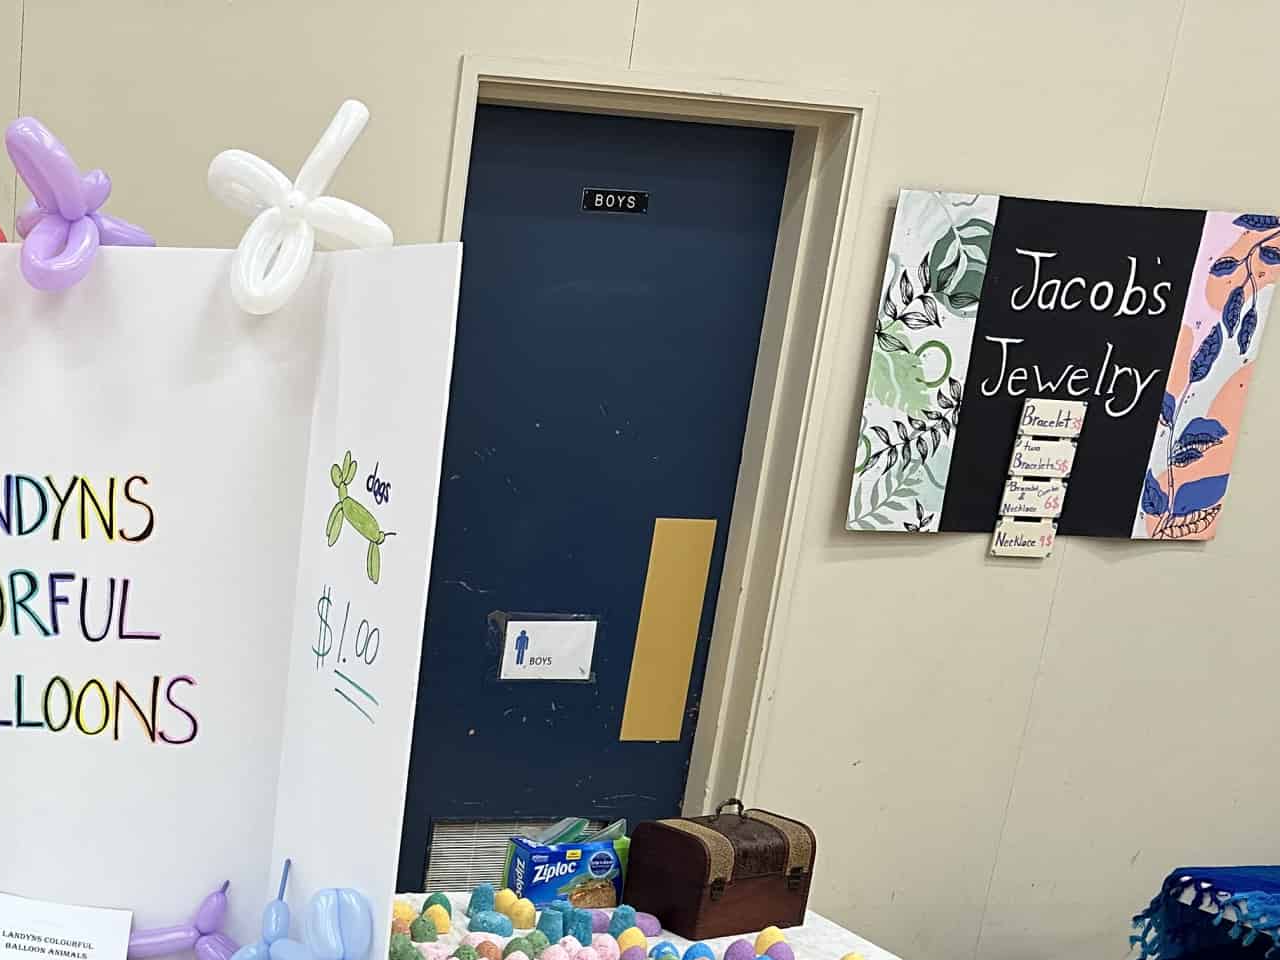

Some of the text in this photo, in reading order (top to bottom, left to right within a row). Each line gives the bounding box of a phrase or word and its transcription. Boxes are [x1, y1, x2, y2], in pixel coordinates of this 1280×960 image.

[594, 193, 637, 209] BOYS
[1011, 247, 1172, 318] Jacob's
[981, 335, 1161, 418] Jewelry
[1022, 404, 1072, 428] Bracelet
[366, 460, 392, 505] dogs
[311, 584, 380, 671] $1.00
[529, 656, 553, 666] BOYS
[532, 861, 577, 883] Ziploc
[2, 930, 95, 950] LANDYNS COLOURFUL
[5, 942, 88, 960] BALLOON ANIMALS
